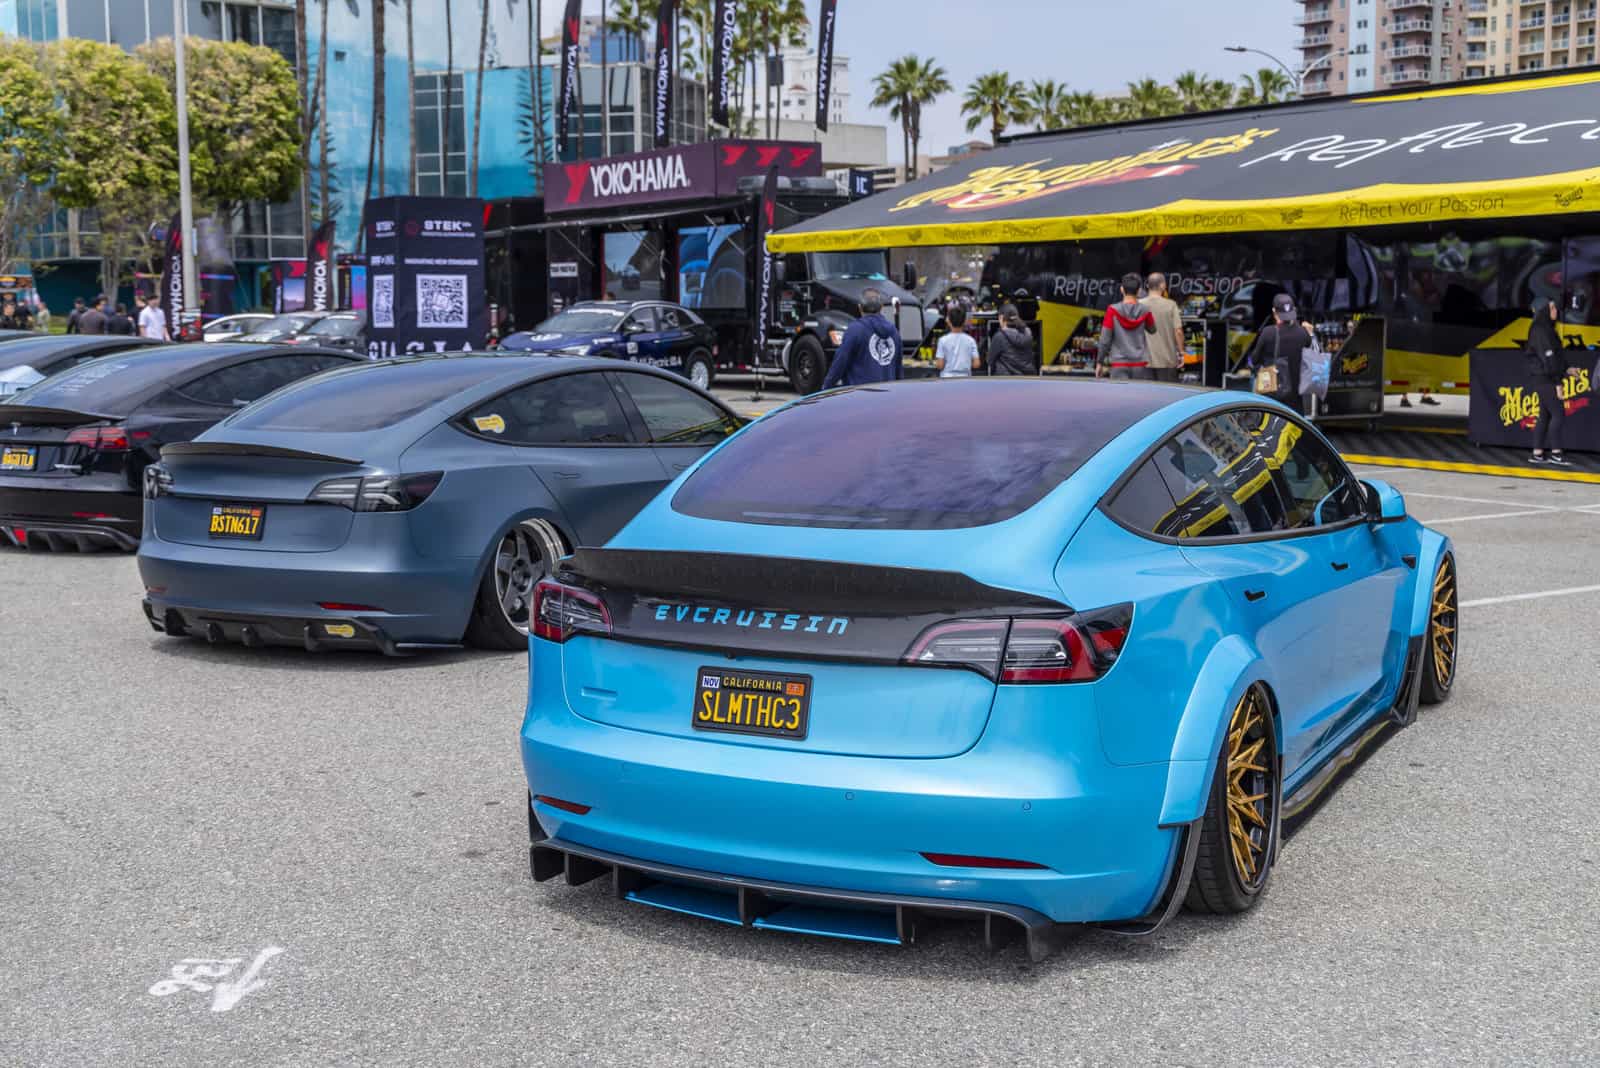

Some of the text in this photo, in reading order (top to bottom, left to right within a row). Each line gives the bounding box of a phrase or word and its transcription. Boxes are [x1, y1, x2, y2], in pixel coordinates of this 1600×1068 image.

[819, 11, 834, 110] YOOHAMA
[590, 154, 688, 197] YOKOHAMA
[1163, 214, 1190, 229] Your
[1193, 213, 1243, 227] Passion
[1339, 195, 1504, 221] Reflect Your Passion
[424, 220, 463, 231] STEK
[171, 254, 182, 340] YOKOHAMA
[314, 259, 327, 312] YOKOHA
[759, 229, 772, 349] KOHAMA
[1168, 273, 1244, 294] Passion
[210, 515, 259, 535] BSTN617
[655, 604, 849, 635] EVCRUISIN
[703, 677, 719, 687] NOV
[723, 677, 782, 691] CALIFORNIA
[699, 691, 801, 730] SLMTHC3
